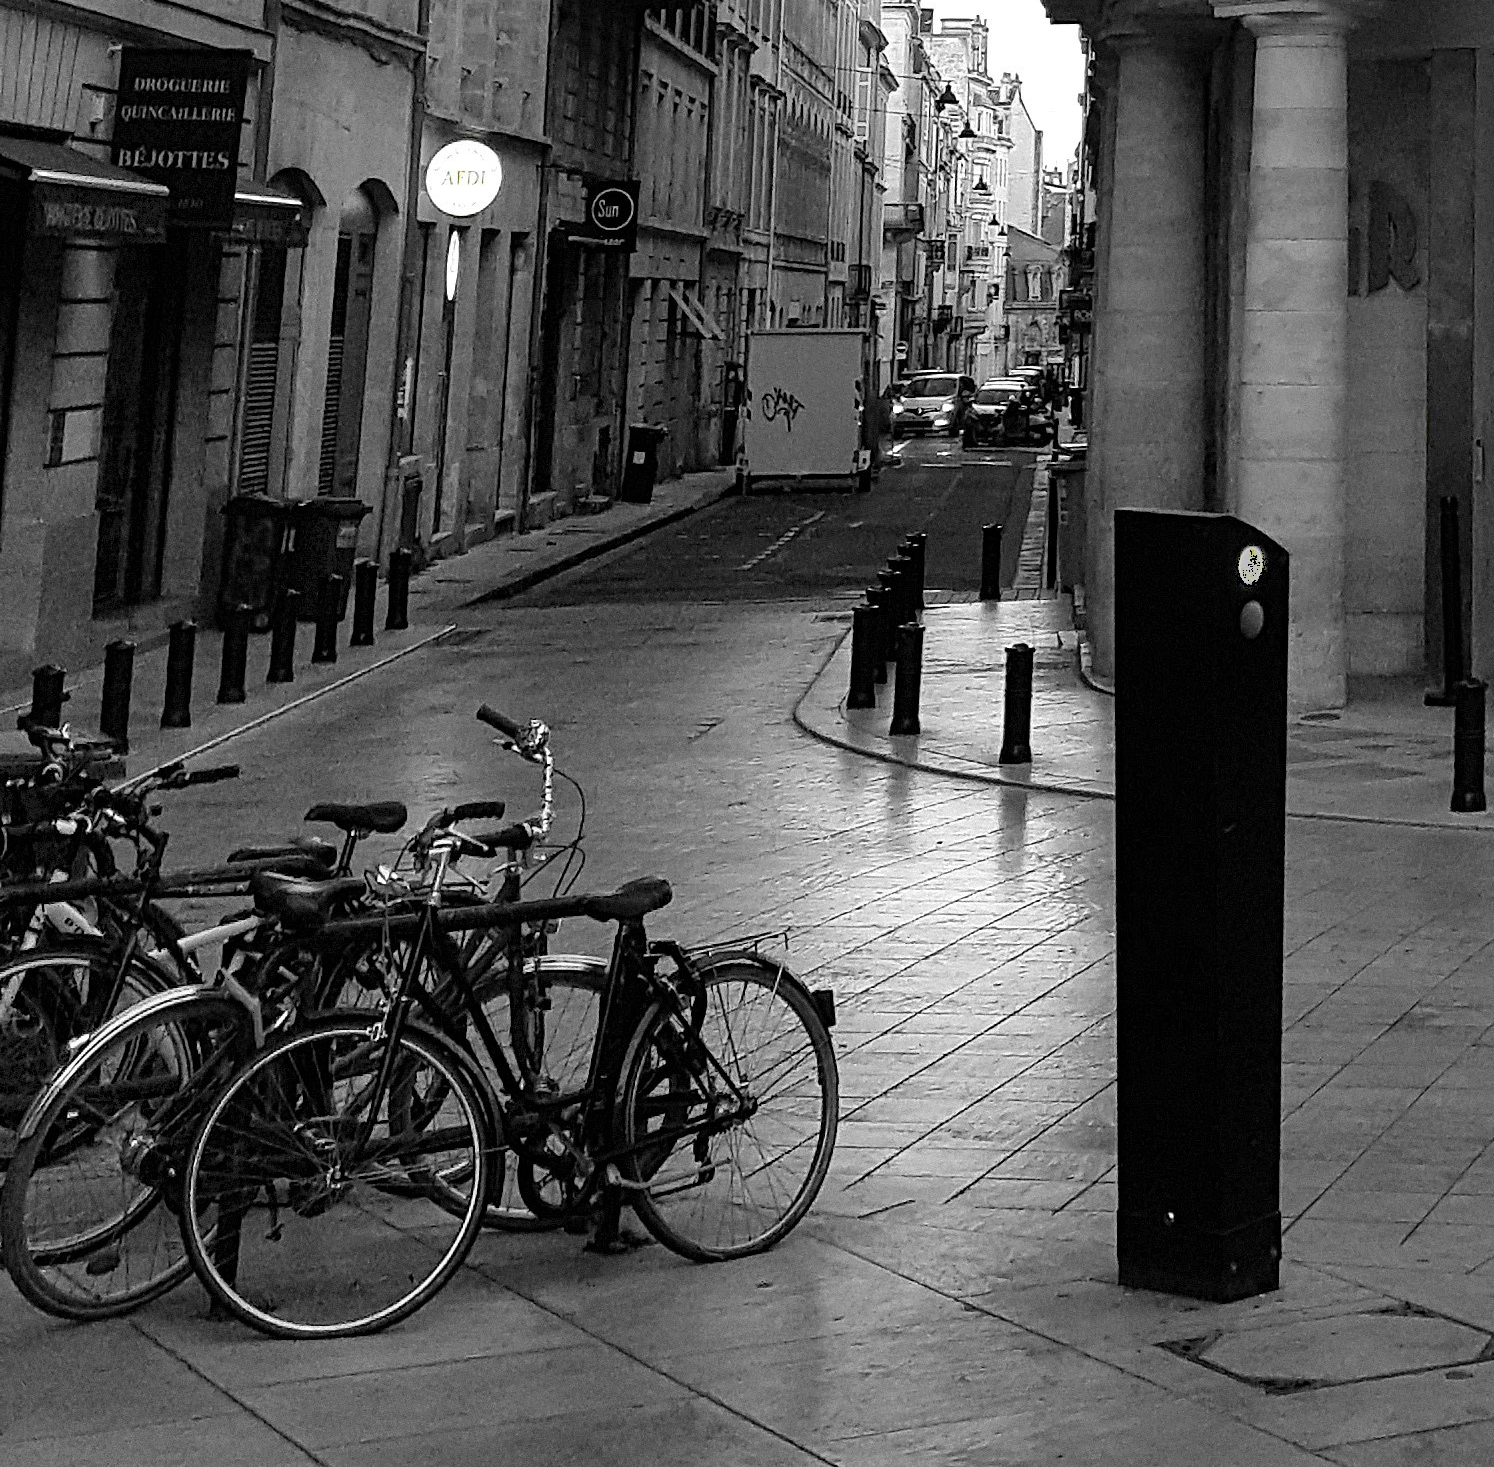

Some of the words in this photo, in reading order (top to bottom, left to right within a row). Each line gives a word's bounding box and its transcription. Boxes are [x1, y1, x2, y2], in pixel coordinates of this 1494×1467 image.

[133, 76, 231, 94] DROGUERIE
[120, 105, 236, 122] QUINCAILLERIE
[117, 144, 230, 170] BÉJOTTES
[597, 199, 619, 219] Sun
